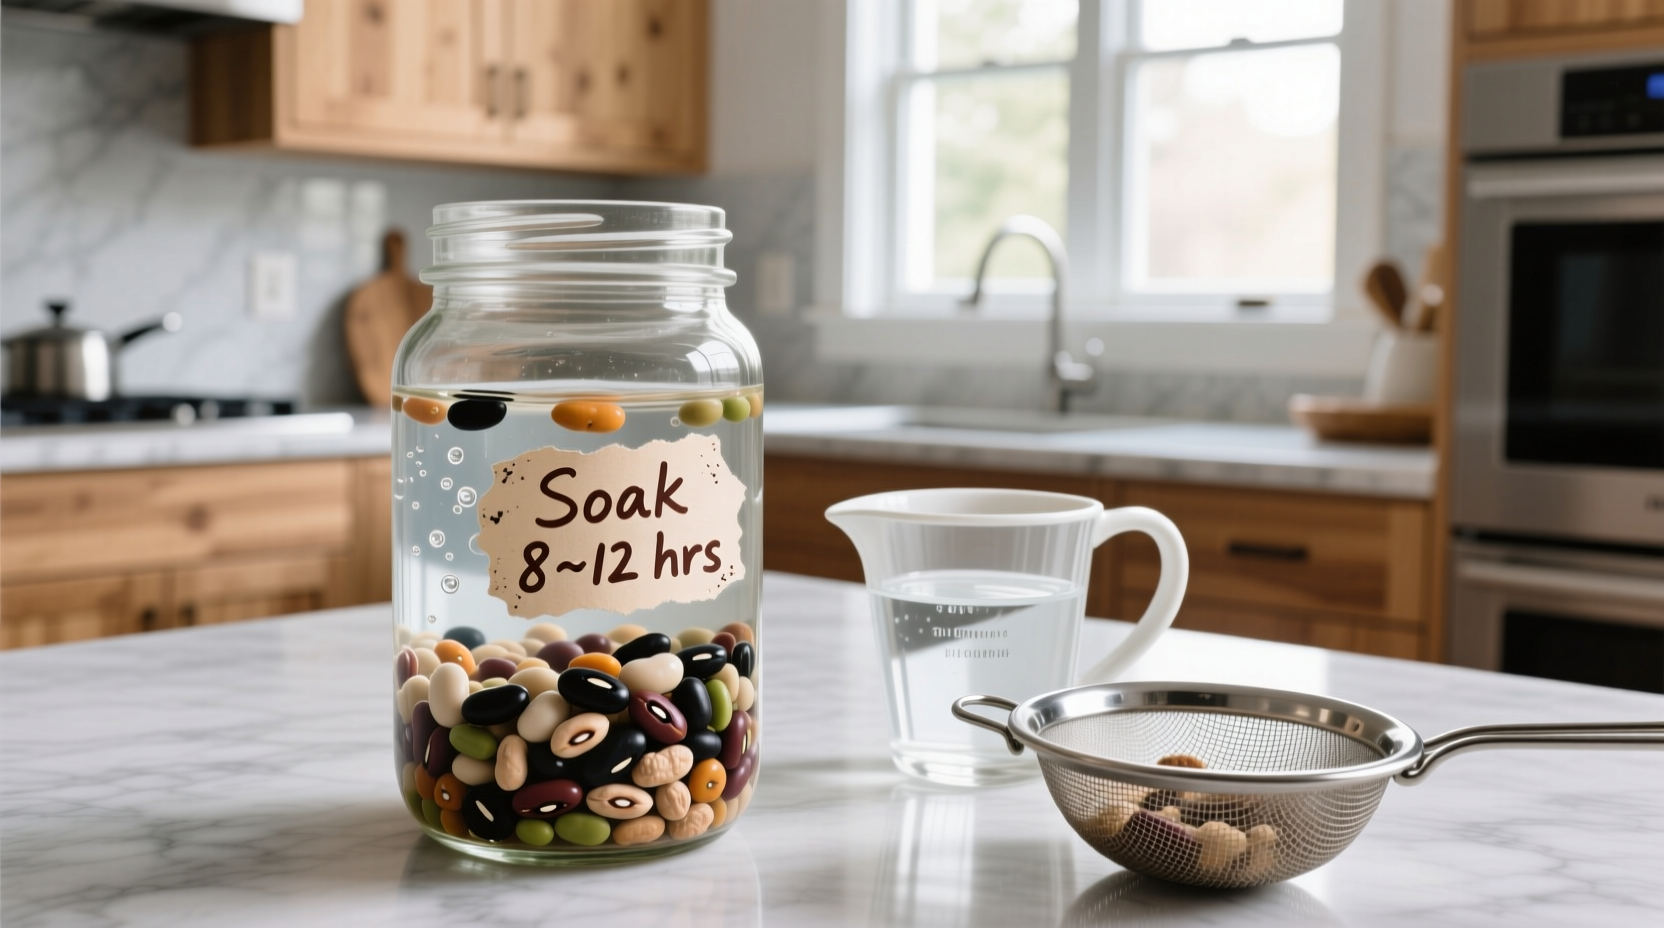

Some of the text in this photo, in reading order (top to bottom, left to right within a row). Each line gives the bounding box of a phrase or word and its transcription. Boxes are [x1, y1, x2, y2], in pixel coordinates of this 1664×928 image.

[535, 461, 689, 529] Soak
[518, 531, 722, 594] 8~12 hrs
